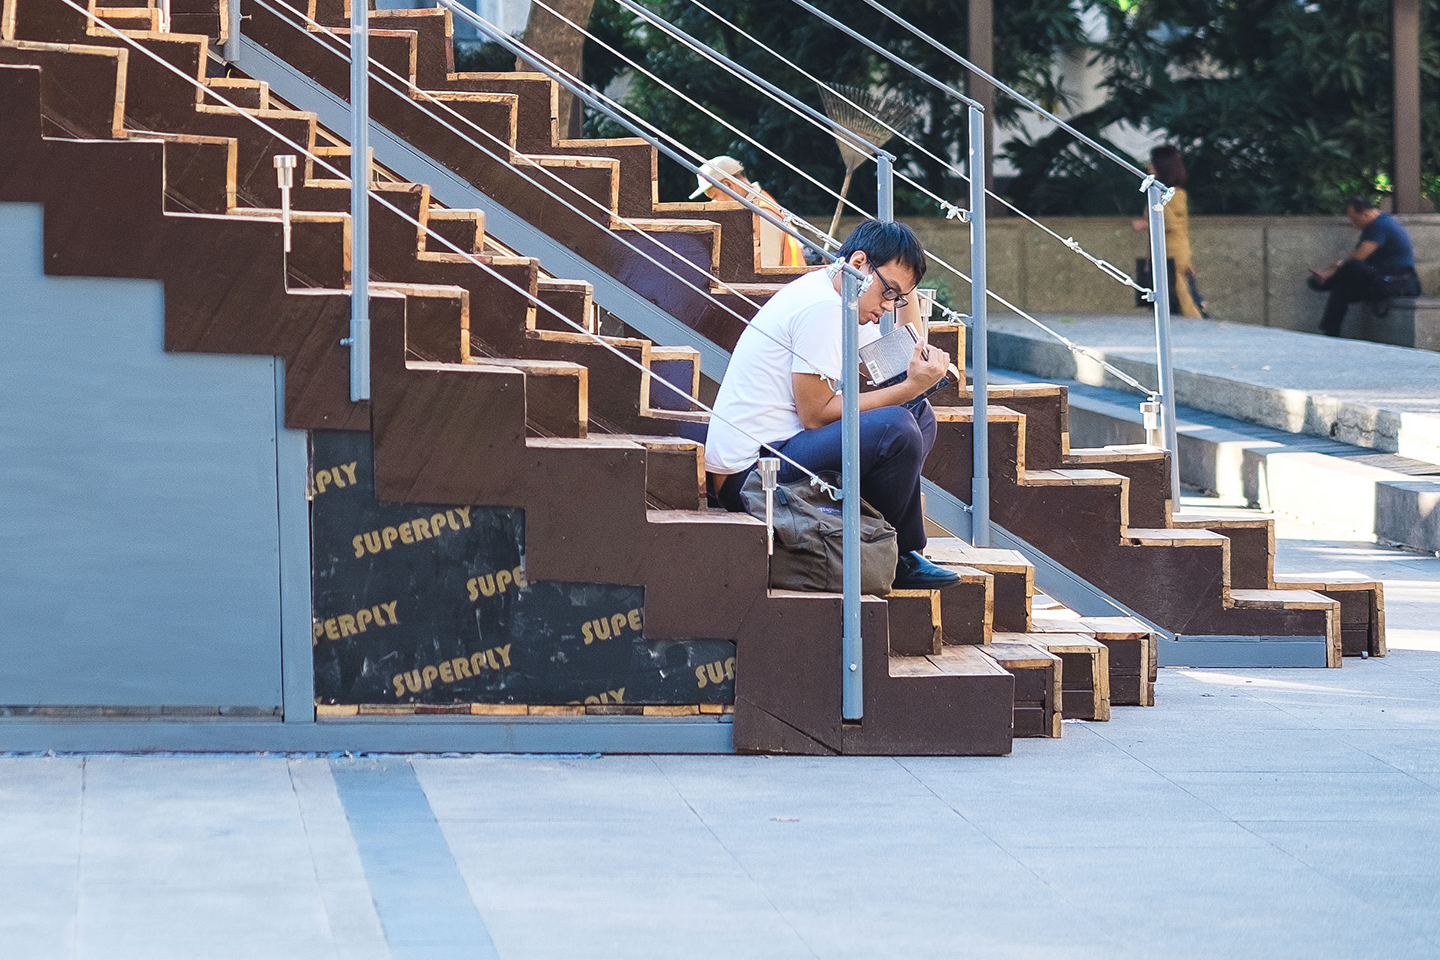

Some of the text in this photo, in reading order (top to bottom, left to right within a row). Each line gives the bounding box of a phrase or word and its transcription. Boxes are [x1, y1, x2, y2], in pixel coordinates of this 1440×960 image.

[351, 505, 472, 559] SUPERPLY
[581, 607, 643, 646] SUPE
[392, 643, 512, 699] SUPERPLY
